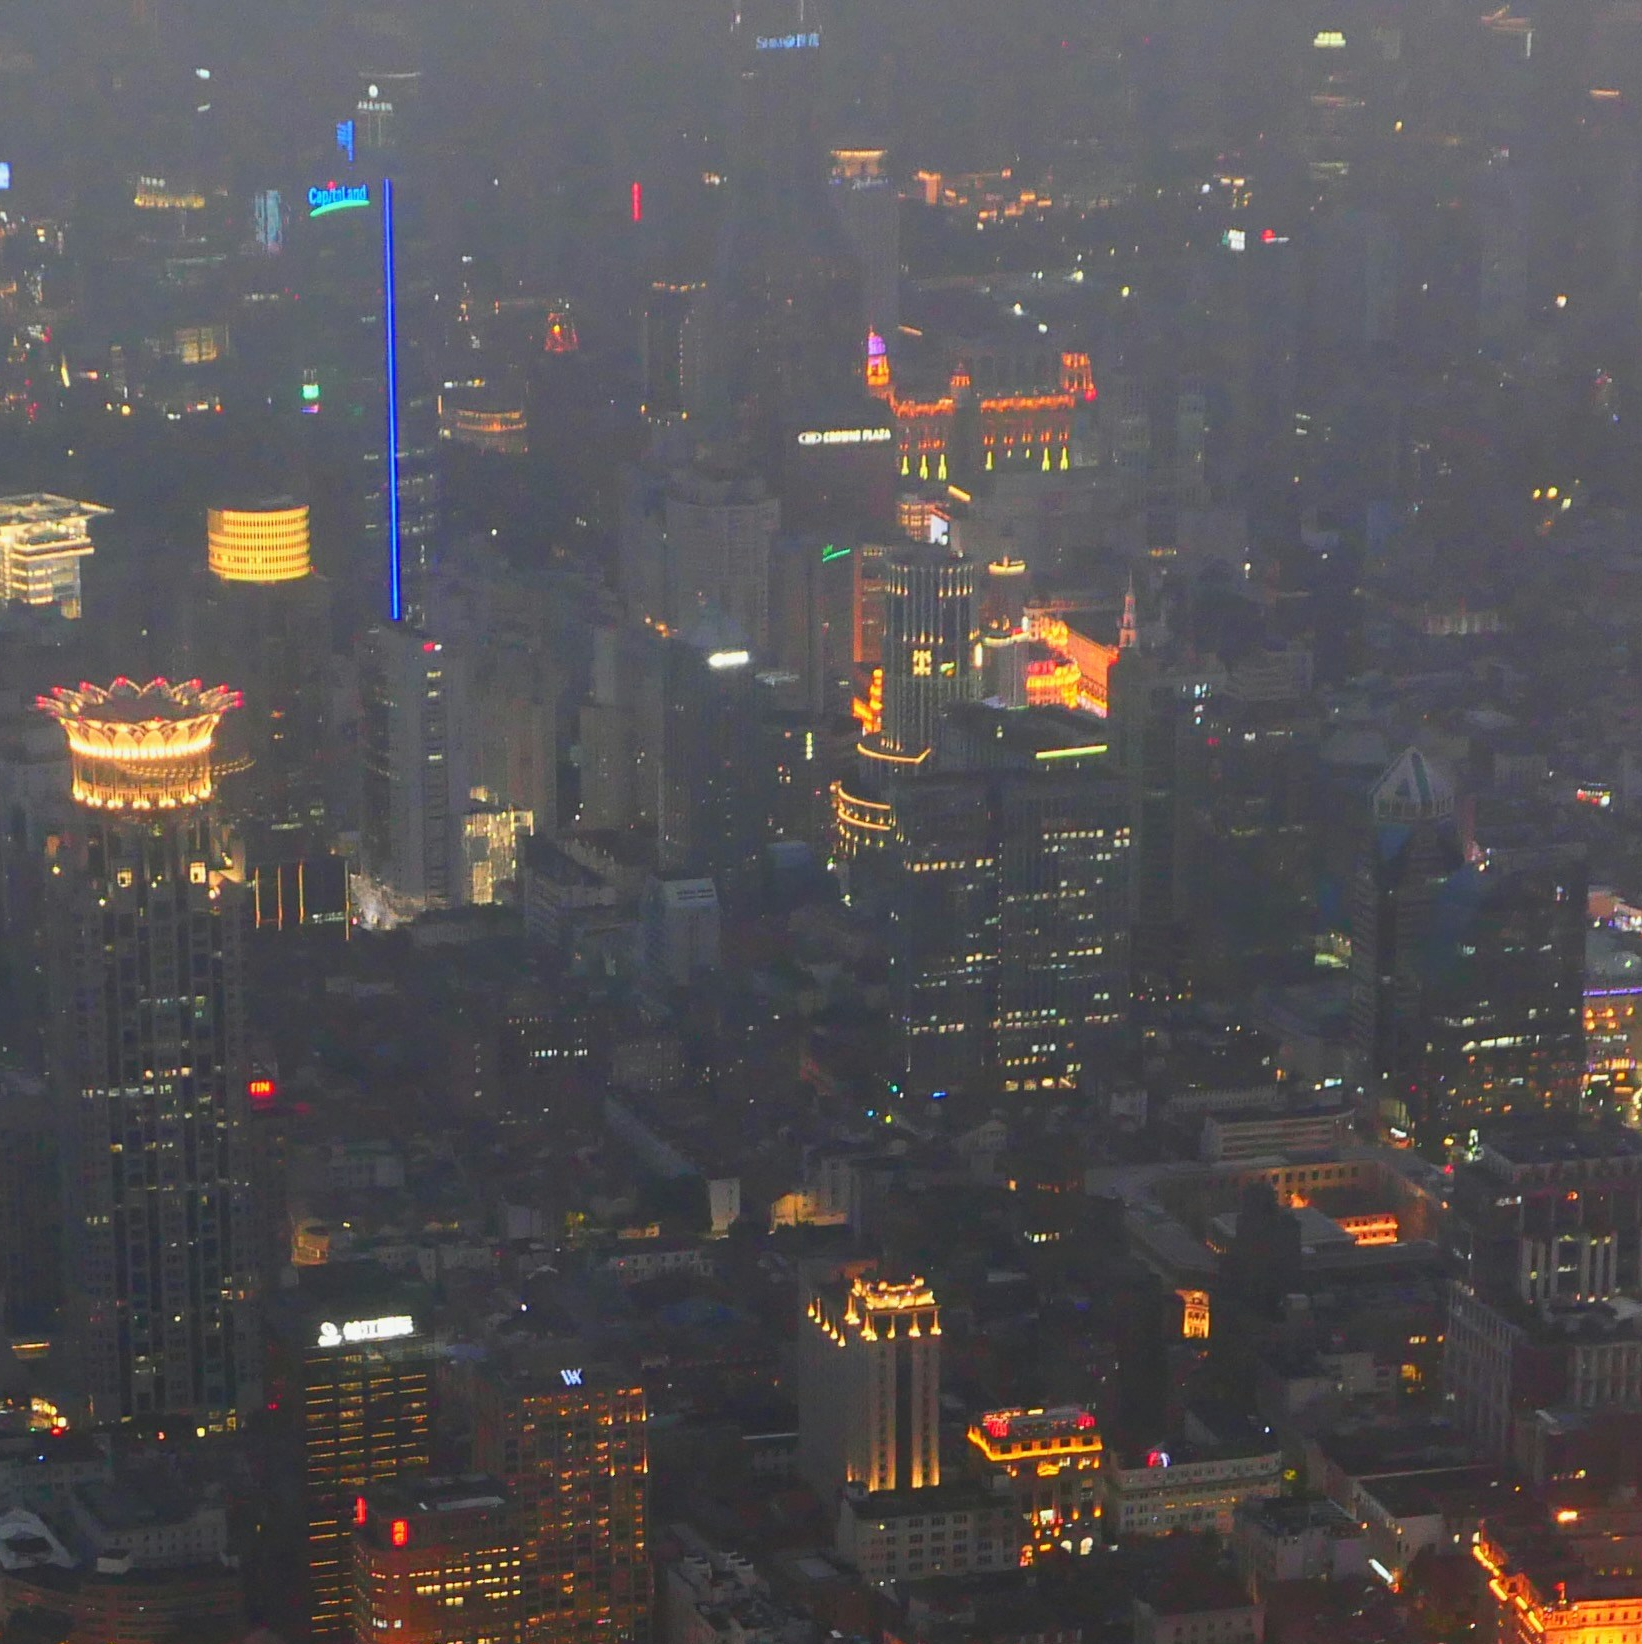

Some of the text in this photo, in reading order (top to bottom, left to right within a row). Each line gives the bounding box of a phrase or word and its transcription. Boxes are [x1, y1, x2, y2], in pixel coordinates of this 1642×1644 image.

[307, 182, 366, 206] CapitaLand
[823, 427, 891, 443] CROWNE PLAZA
